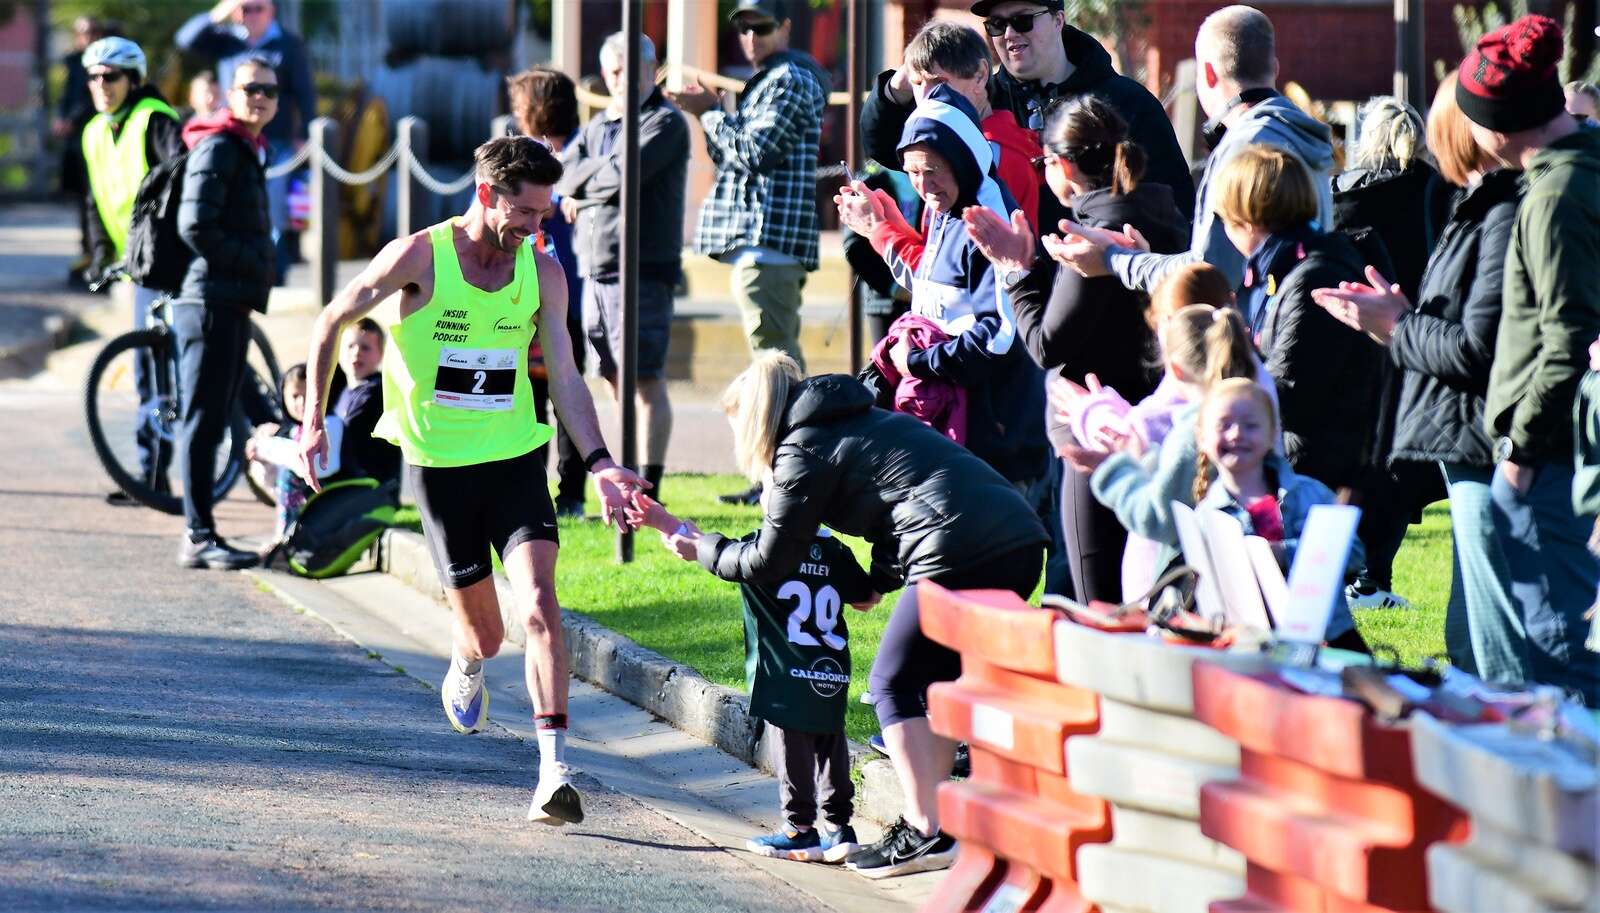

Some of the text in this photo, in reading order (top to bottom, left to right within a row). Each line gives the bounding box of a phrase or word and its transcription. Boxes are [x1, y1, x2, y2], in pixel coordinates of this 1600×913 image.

[442, 309, 469, 319] INSIDE
[435, 320, 471, 331] RUNNING
[432, 332, 469, 343] PODCAST
[471, 370, 487, 394] 2
[799, 563, 830, 577] ATLEY
[789, 668, 850, 684] CALEDONIA
